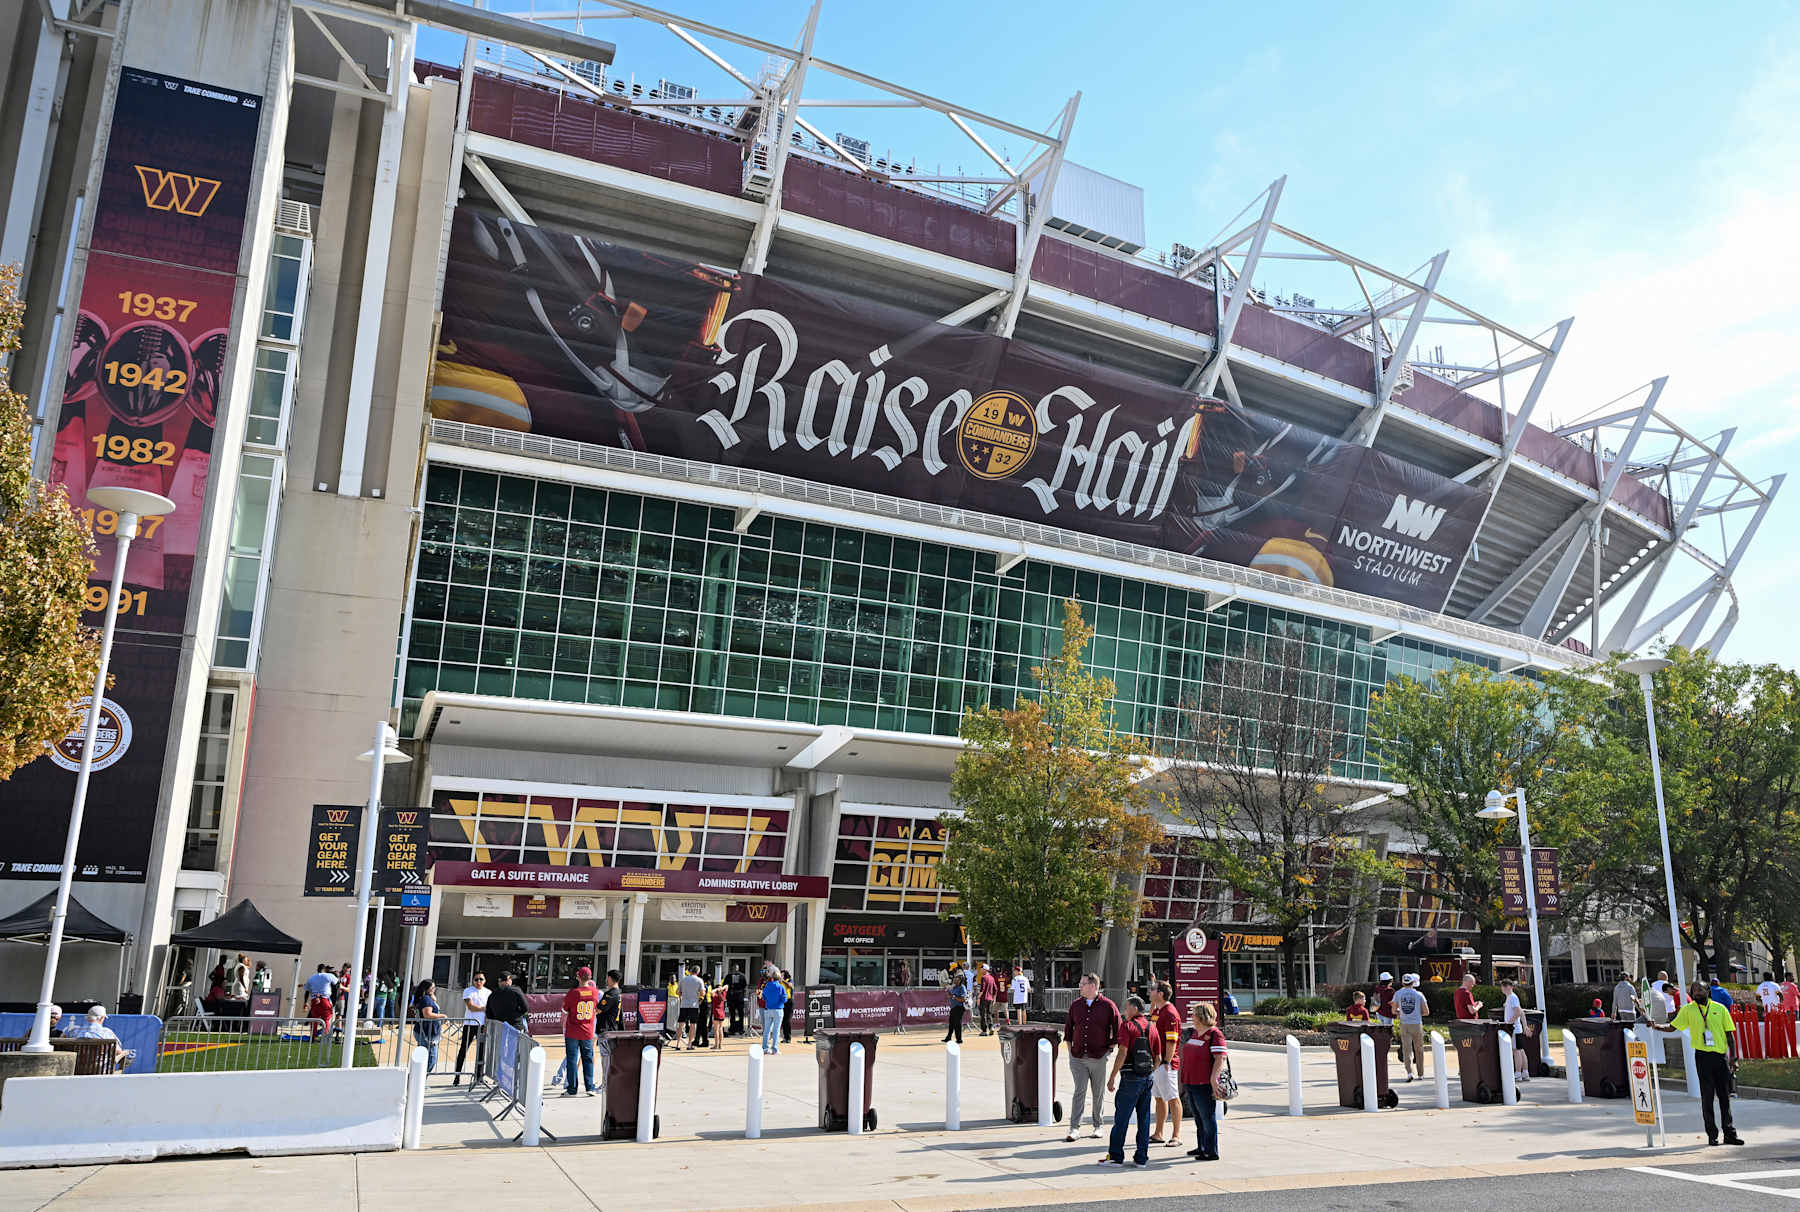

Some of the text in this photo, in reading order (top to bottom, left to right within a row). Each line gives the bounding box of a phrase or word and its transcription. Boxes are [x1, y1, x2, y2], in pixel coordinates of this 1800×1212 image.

[184, 85, 201, 95] TAKE
[201, 89, 239, 103] COMMAND
[118, 291, 198, 323] 1937
[104, 361, 187, 395] 1942
[695, 309, 1195, 520] Raise Hail
[984, 407, 999, 420] 19
[965, 422, 1030, 449] COMMANDERS
[92, 433, 176, 466] 1982
[995, 452, 1011, 465] 32
[1337, 525, 1452, 574] NORTHWEST
[1353, 555, 1423, 586] STADIUM
[86, 586, 148, 616] 991
[319, 833, 341, 842] GET
[389, 834, 410, 843] GET
[319, 842, 348, 851] YOUR
[389, 843, 417, 852] YOUR
[317, 851, 347, 860] GEAR
[387, 852, 416, 861] GEAR
[11, 863, 33, 872] TAKE
[316, 860, 348, 869] HERE.
[386, 861, 416, 870] HERE.
[471, 869, 589, 883] GATE A SUITE ENTRANCE
[699, 878, 798, 891] ADMINISTRATIVE LOBBY
[833, 923, 887, 937] SEATGEEK
[1243, 936, 1262, 944] TEAM
[1019, 983, 1025, 993] 5
[577, 1001, 594, 1021] 99
[852, 1006, 894, 1015] NORTHWEST
[1633, 1065, 1646, 1073] STOP
